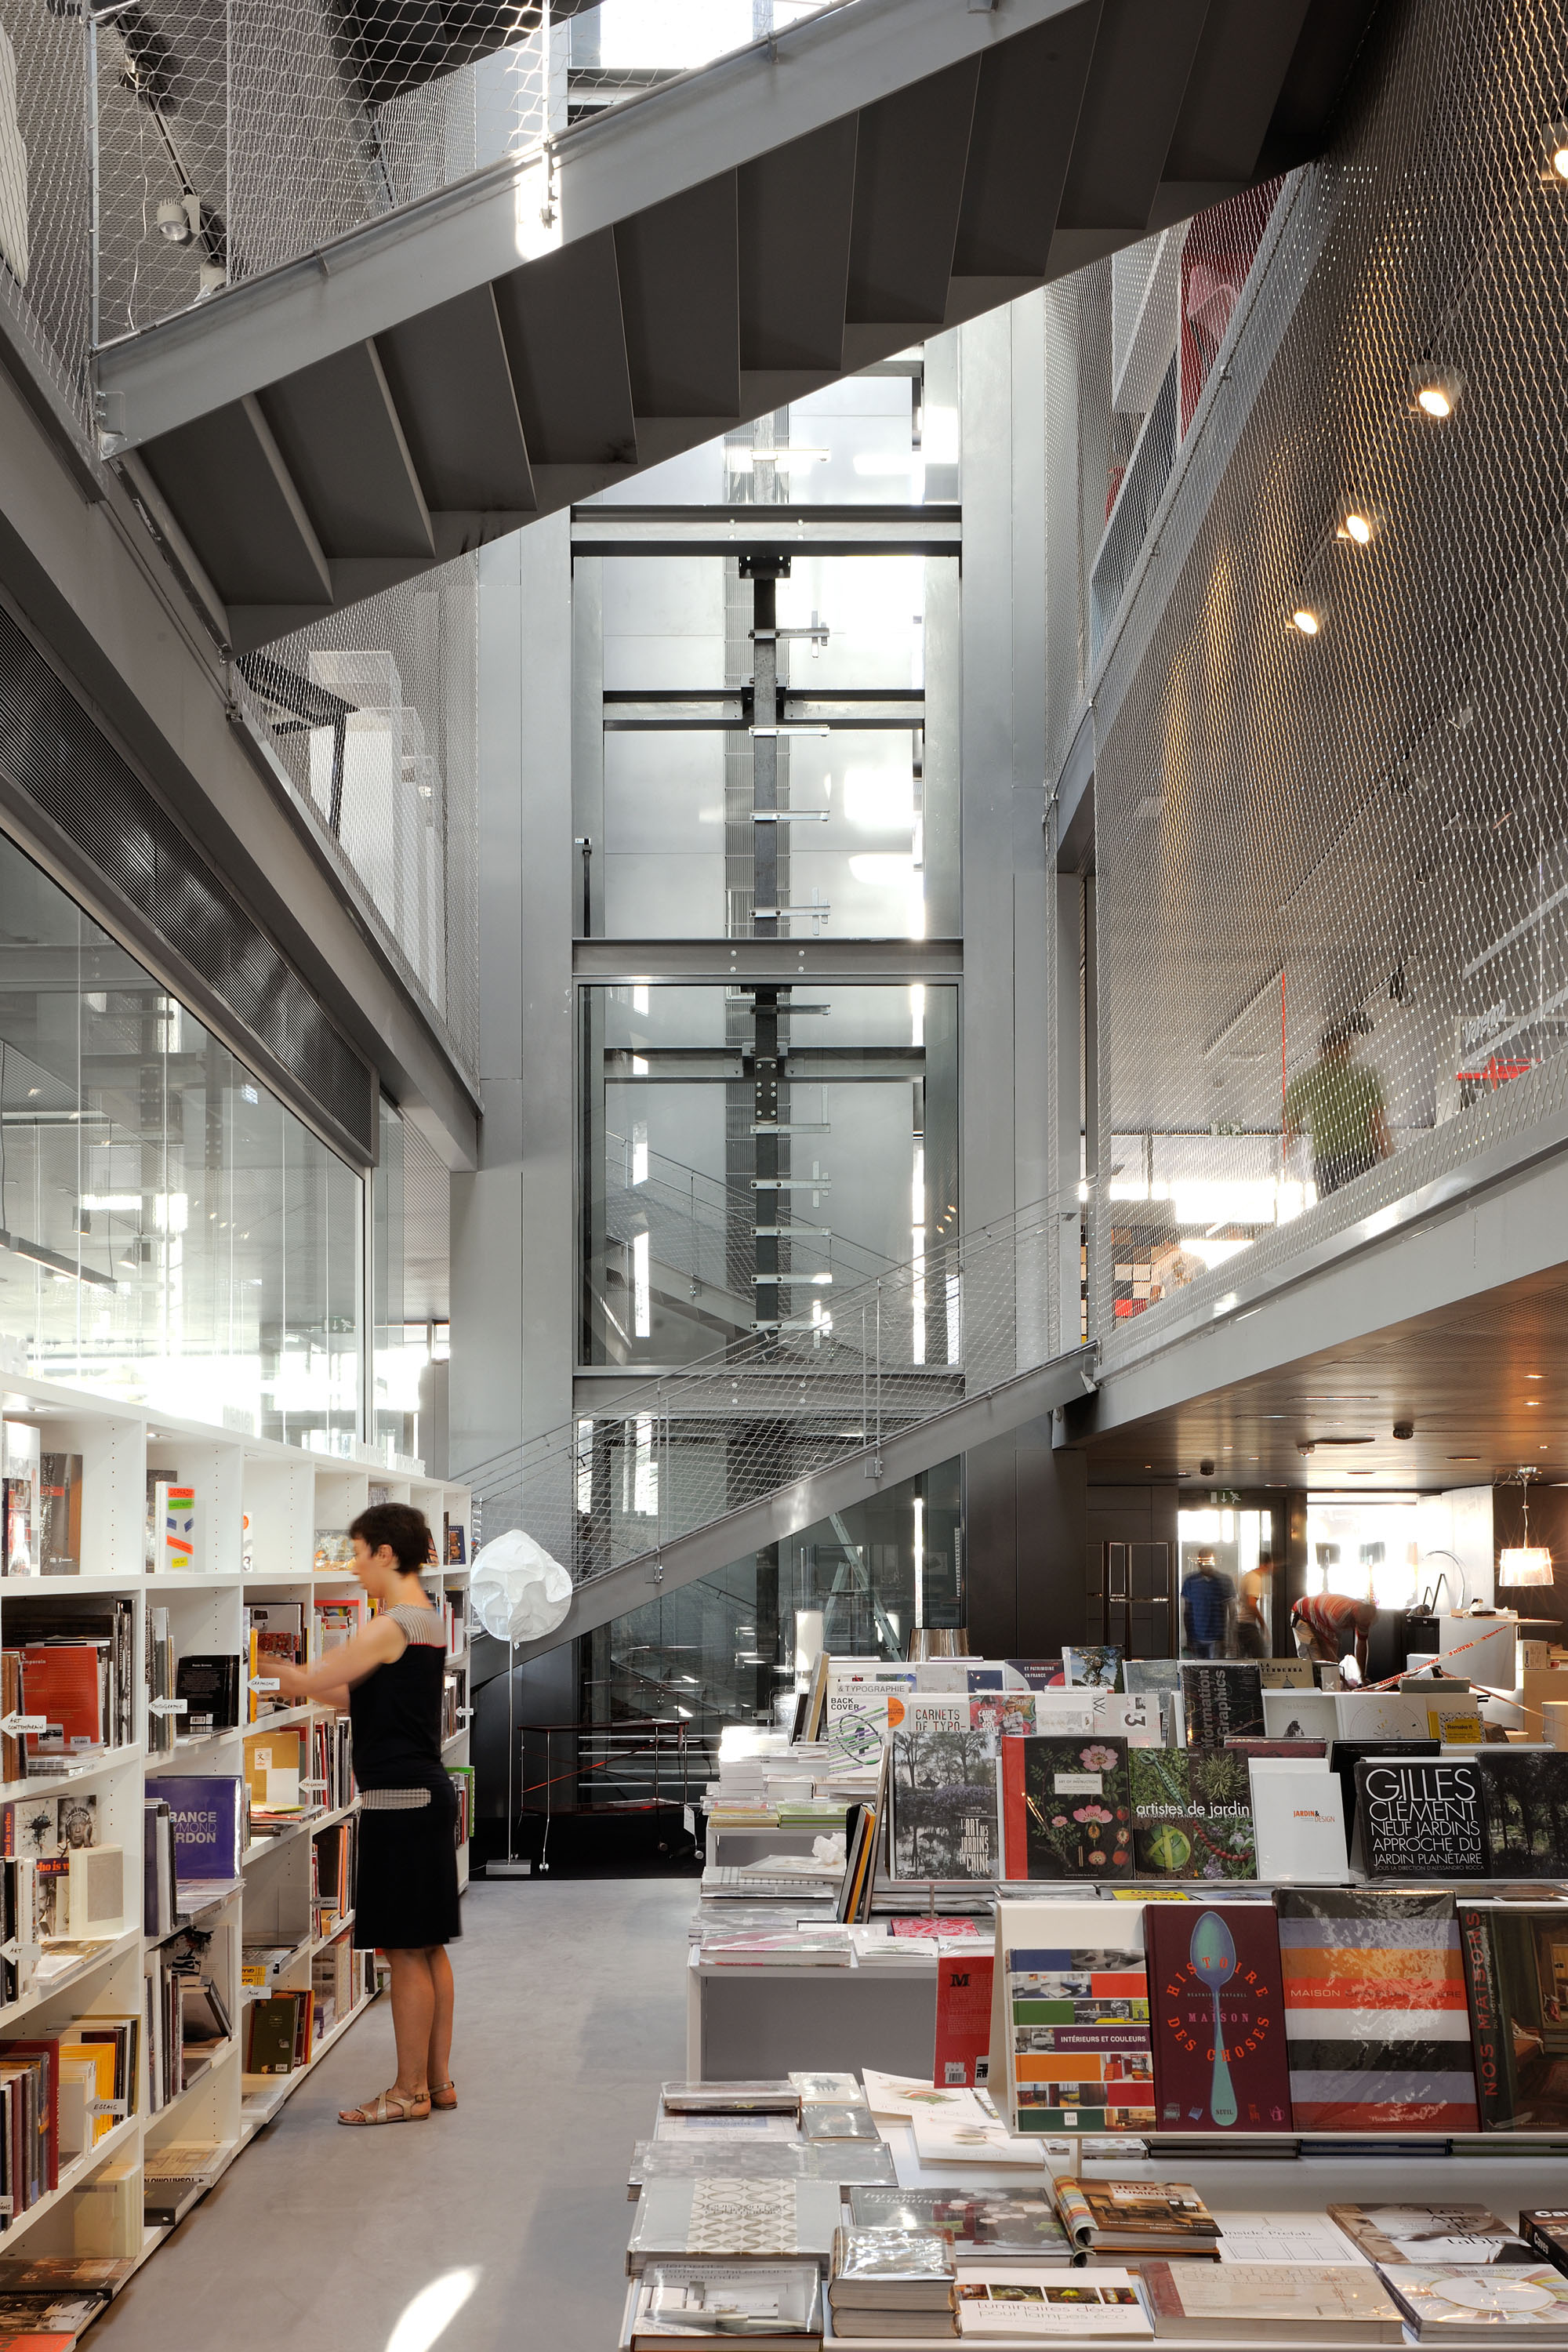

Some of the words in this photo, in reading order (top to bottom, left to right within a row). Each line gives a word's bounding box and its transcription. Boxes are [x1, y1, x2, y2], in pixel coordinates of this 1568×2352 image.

[1198, 1669, 1214, 1748] nformation
[1214, 1670, 1232, 1737] Graphics
[916, 1709, 960, 1720] CARNETS
[1366, 1768, 1475, 1801] GILLES
[1136, 1802, 1182, 1815] artistes
[1188, 1801, 1205, 1815] de
[1207, 1800, 1249, 1819] jardin
[1369, 1795, 1477, 1821] CLÉMENT
[169, 1811, 216, 1823] RANCE
[172, 1823, 216, 1832] YMOND
[1371, 1821, 1411, 1836] NEUF
[1414, 1820, 1480, 1838] JARDINS
[175, 1832, 216, 1843] RDON
[960, 1837, 989, 1853] JARDINS
[1373, 1838, 1453, 1851] APPROCHE
[1459, 1838, 1481, 1851] DU
[967, 1853, 989, 1872] CHINE
[1374, 1853, 1414, 1866] JARDIN
[1418, 1850, 1483, 1864] PLANÉTAIRE
[1167, 1957, 1269, 1997] HISTOIRE
[1466, 1912, 1490, 2029] MAISONS
[950, 1973, 971, 1987] M
[1290, 1989, 1341, 1998] MAISON
[1189, 2013, 1249, 2022] MAISON
[1167, 2017, 1197, 2051] DES
[1207, 2016, 1269, 2062] CHOSES
[1480, 2044, 1498, 2096] NOS
[1447, 2237, 1508, 2245] table
[1534, 2232, 1549, 2255] Caves
[1025, 2311, 1088, 2321] lampes
